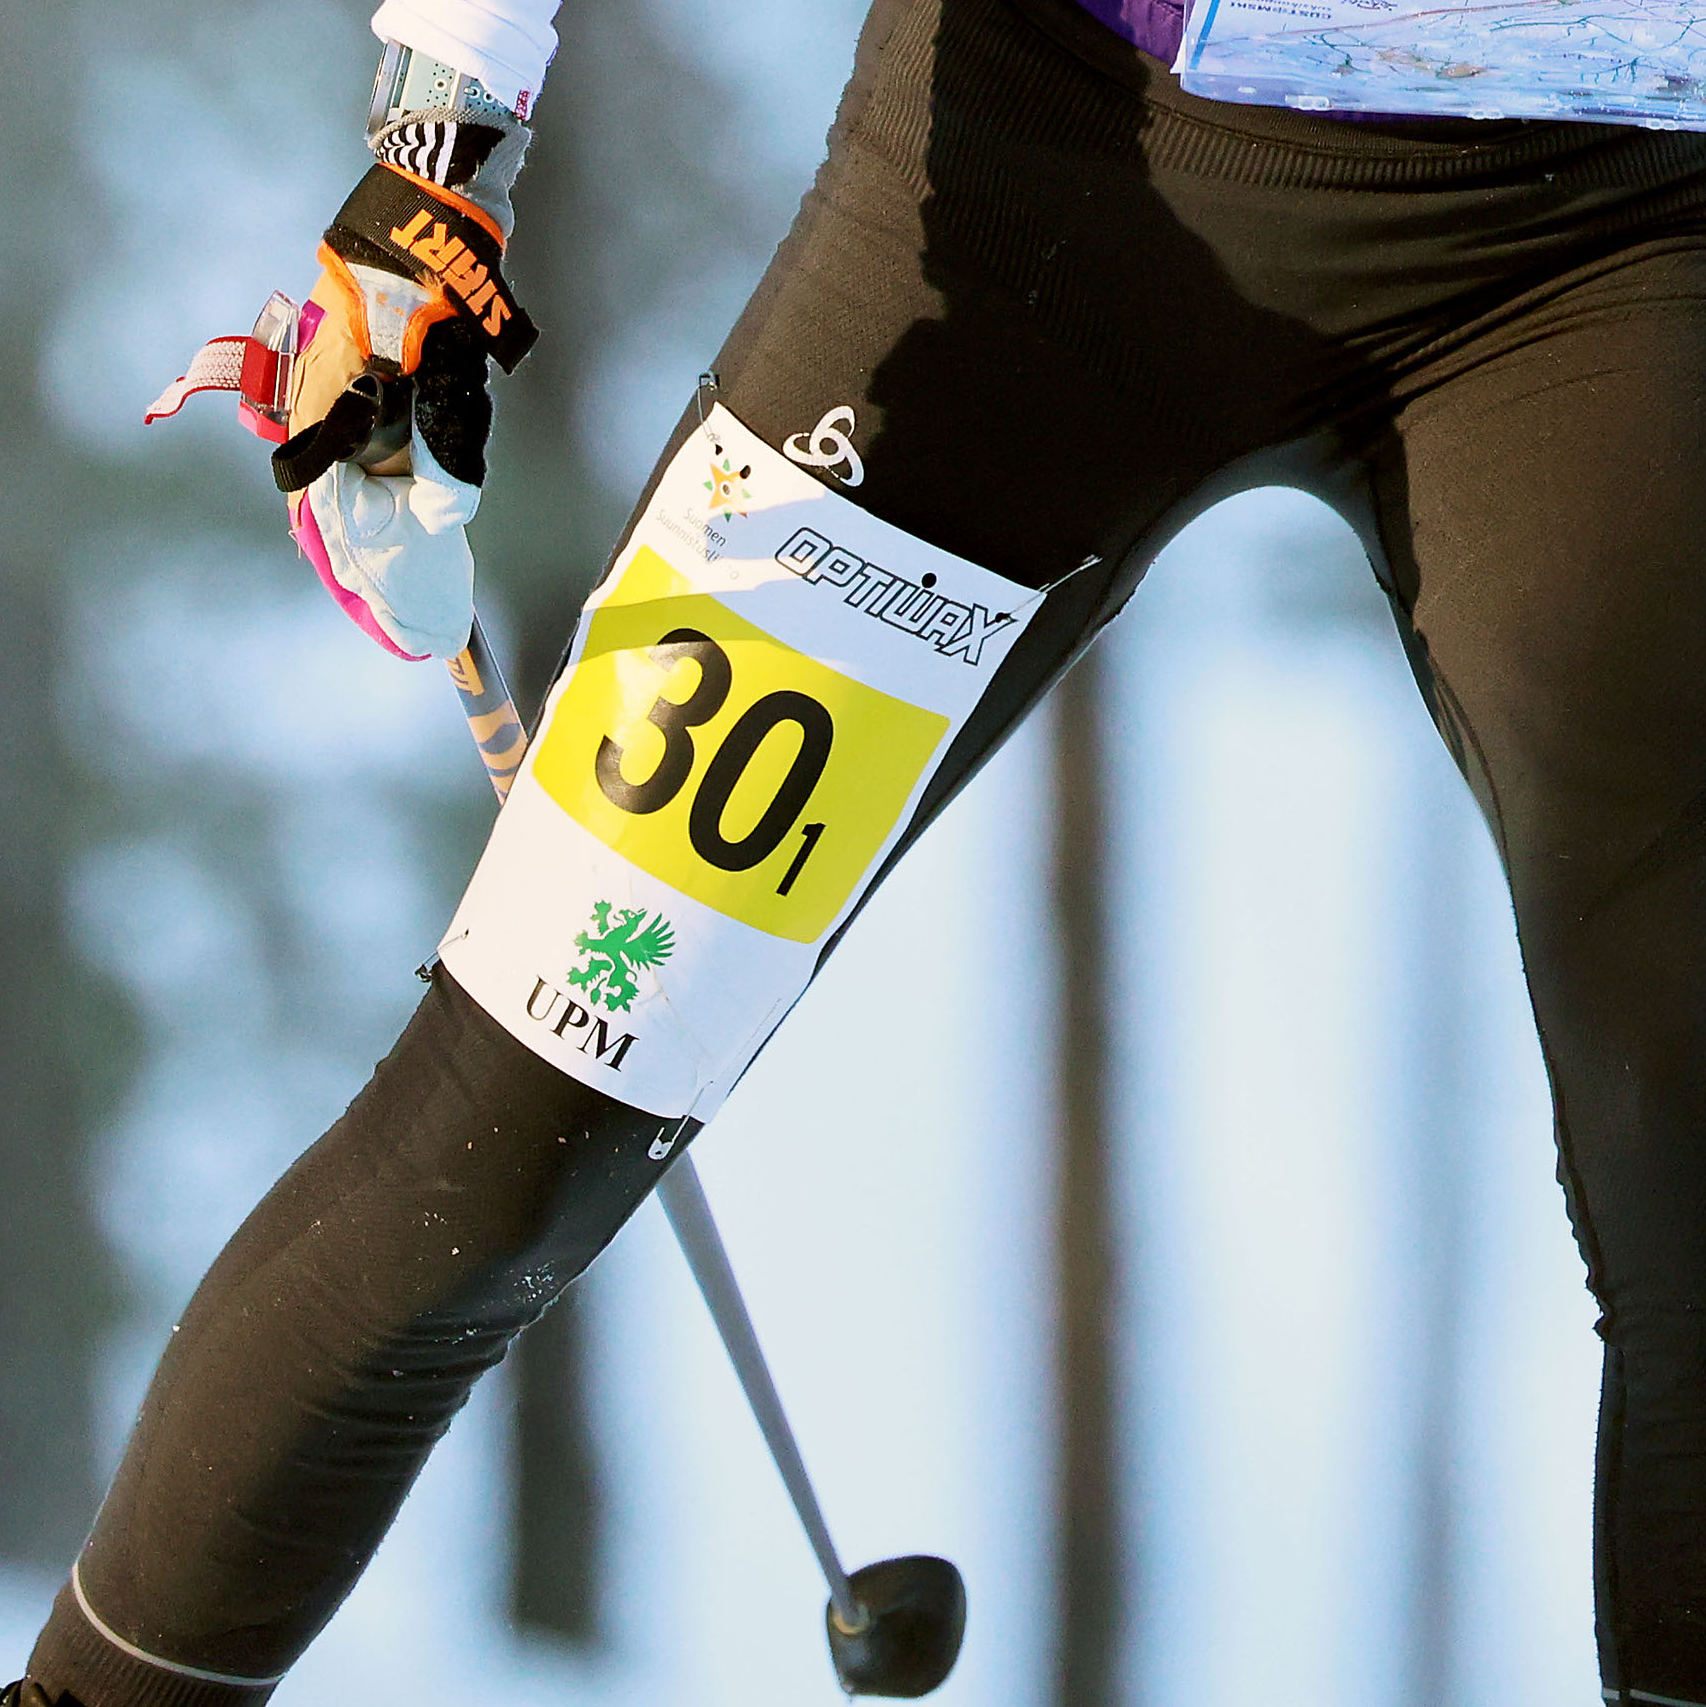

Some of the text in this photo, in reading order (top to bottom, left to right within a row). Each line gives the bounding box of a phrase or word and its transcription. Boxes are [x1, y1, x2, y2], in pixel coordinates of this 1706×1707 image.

[389, 208, 512, 337] START
[683, 507, 727, 547] Suomen
[774, 526, 1019, 667] OPTIWAX
[594, 627, 834, 897] 30 1
[525, 974, 641, 1073] UPM
